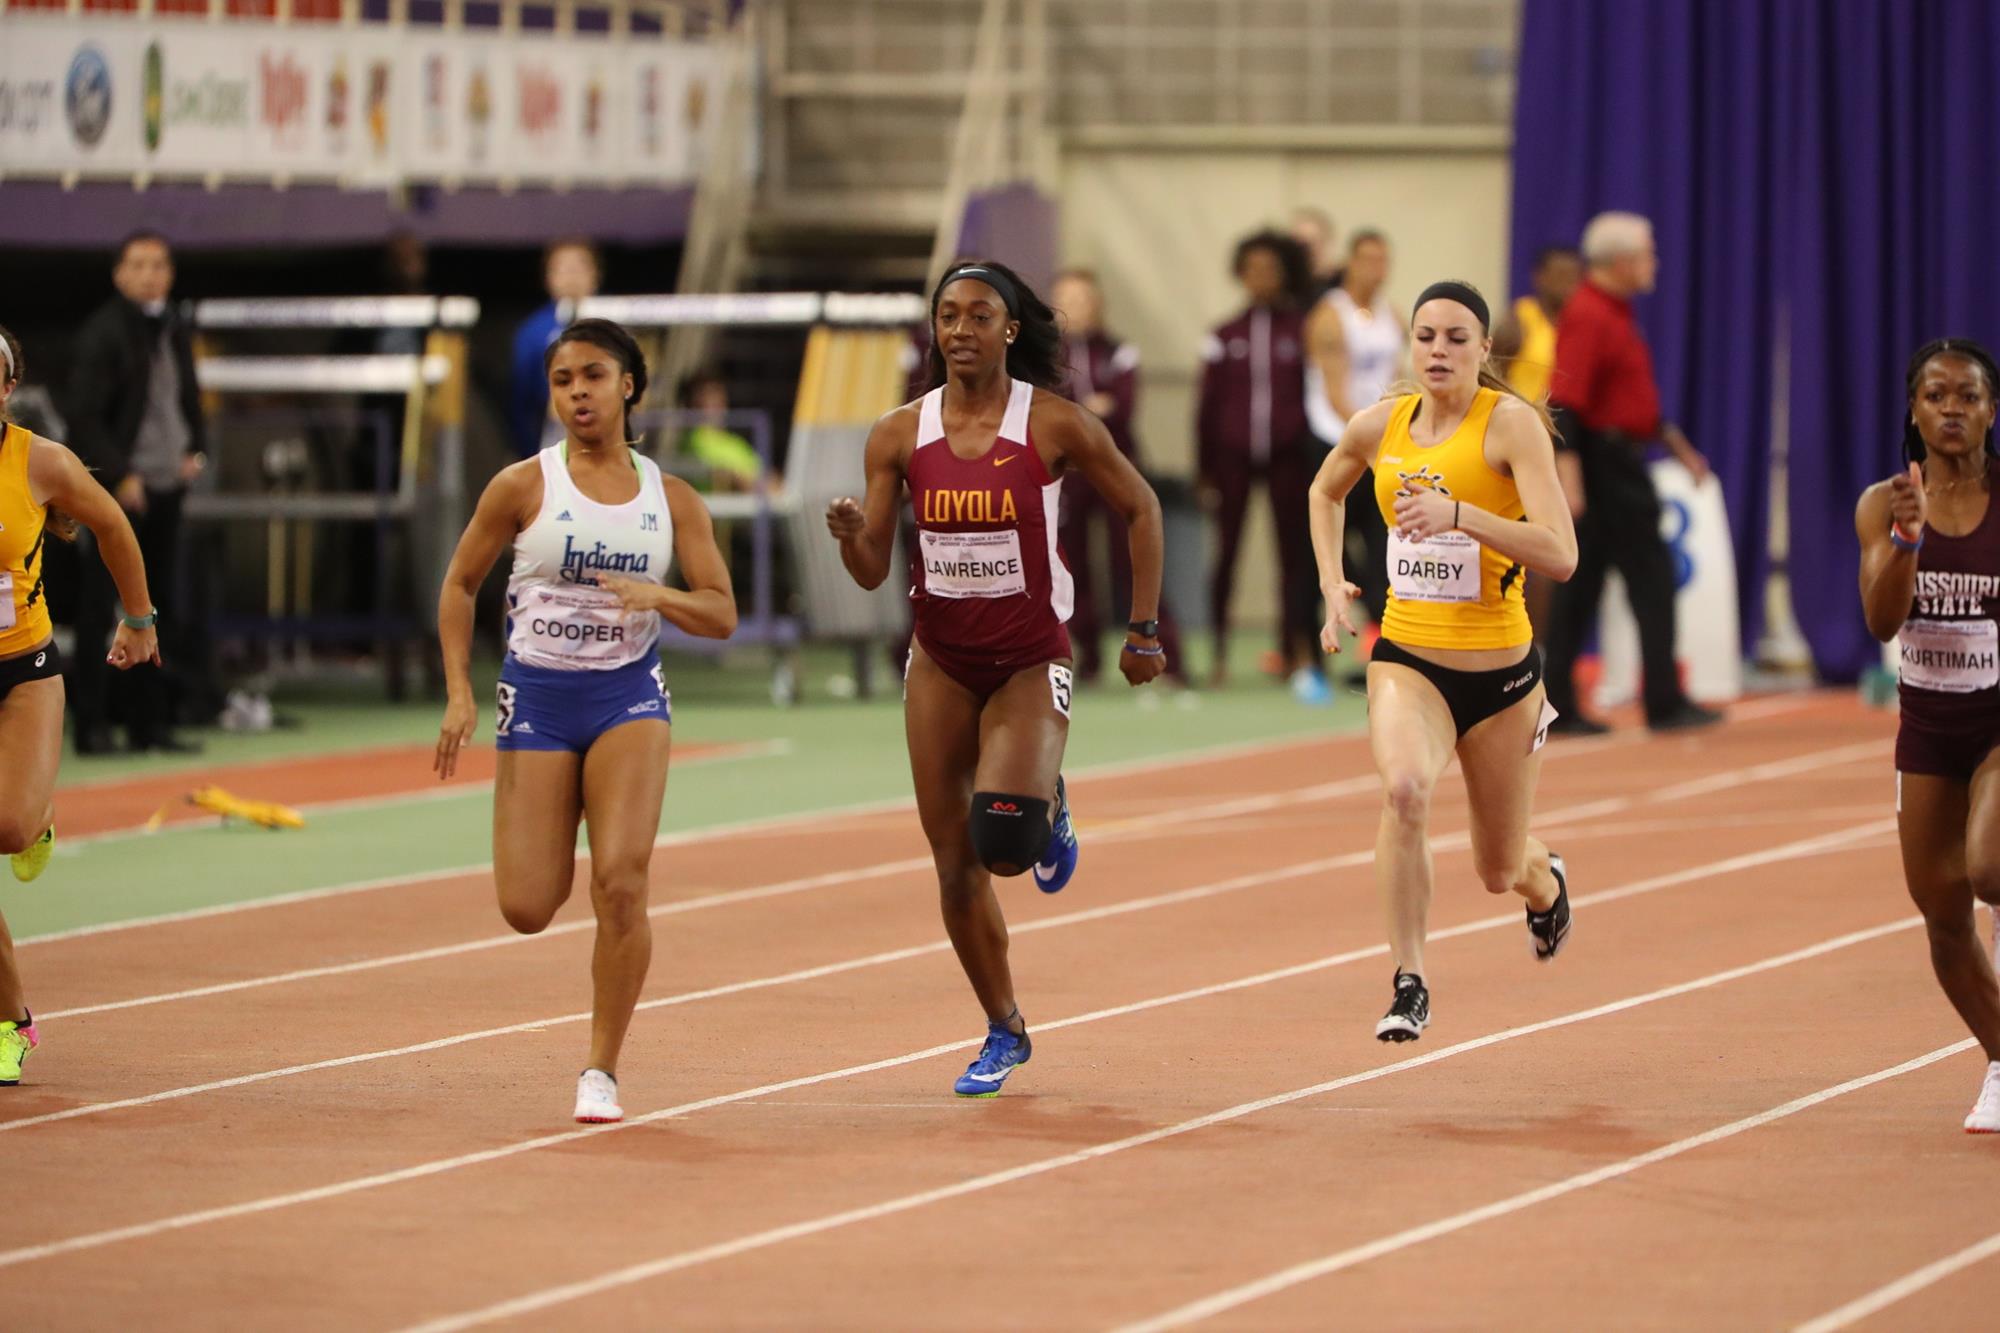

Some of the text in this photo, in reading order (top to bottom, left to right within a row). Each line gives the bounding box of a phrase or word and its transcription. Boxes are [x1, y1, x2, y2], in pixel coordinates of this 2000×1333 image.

[924, 489, 1017, 522] LOYOLA
[640, 513, 658, 531] JM
[560, 534, 648, 575] Indiana
[926, 558, 1019, 578] LAWRENCE
[1397, 559, 1463, 580] DARBY
[1914, 571, 2000, 598] ISSOURI
[532, 618, 624, 642] COOPER
[1901, 645, 1993, 670] KURTIMAH
